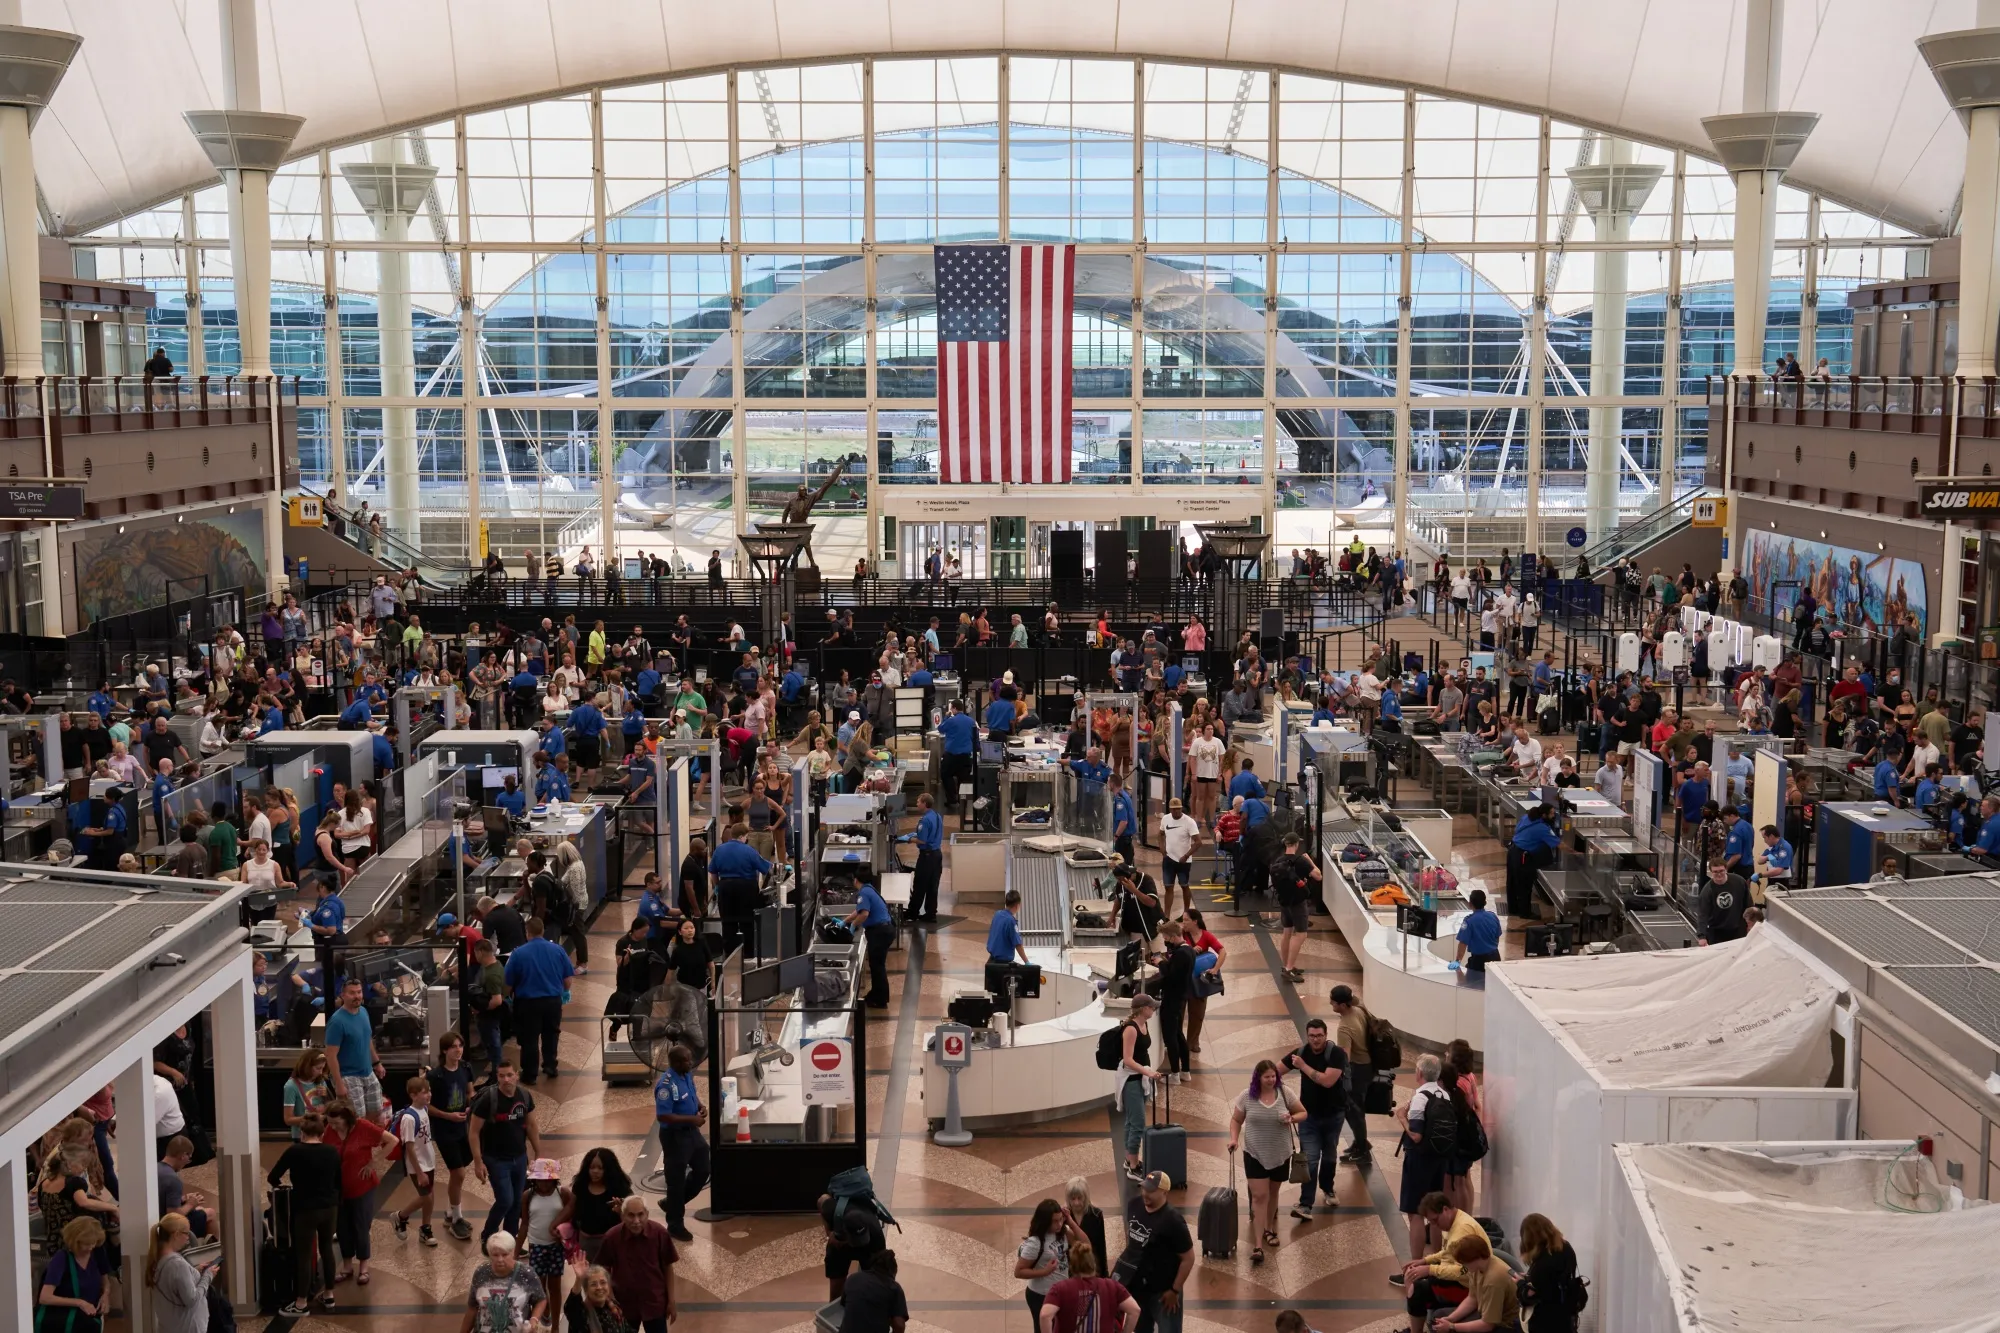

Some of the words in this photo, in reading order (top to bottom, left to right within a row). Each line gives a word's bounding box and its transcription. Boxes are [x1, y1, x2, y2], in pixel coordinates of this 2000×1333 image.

[8, 491, 26, 501] TSA
[28, 491, 43, 501] Pre
[1925, 492, 2000, 508] SUBWA
[1733, 1018, 1771, 1034] RETARDANT
